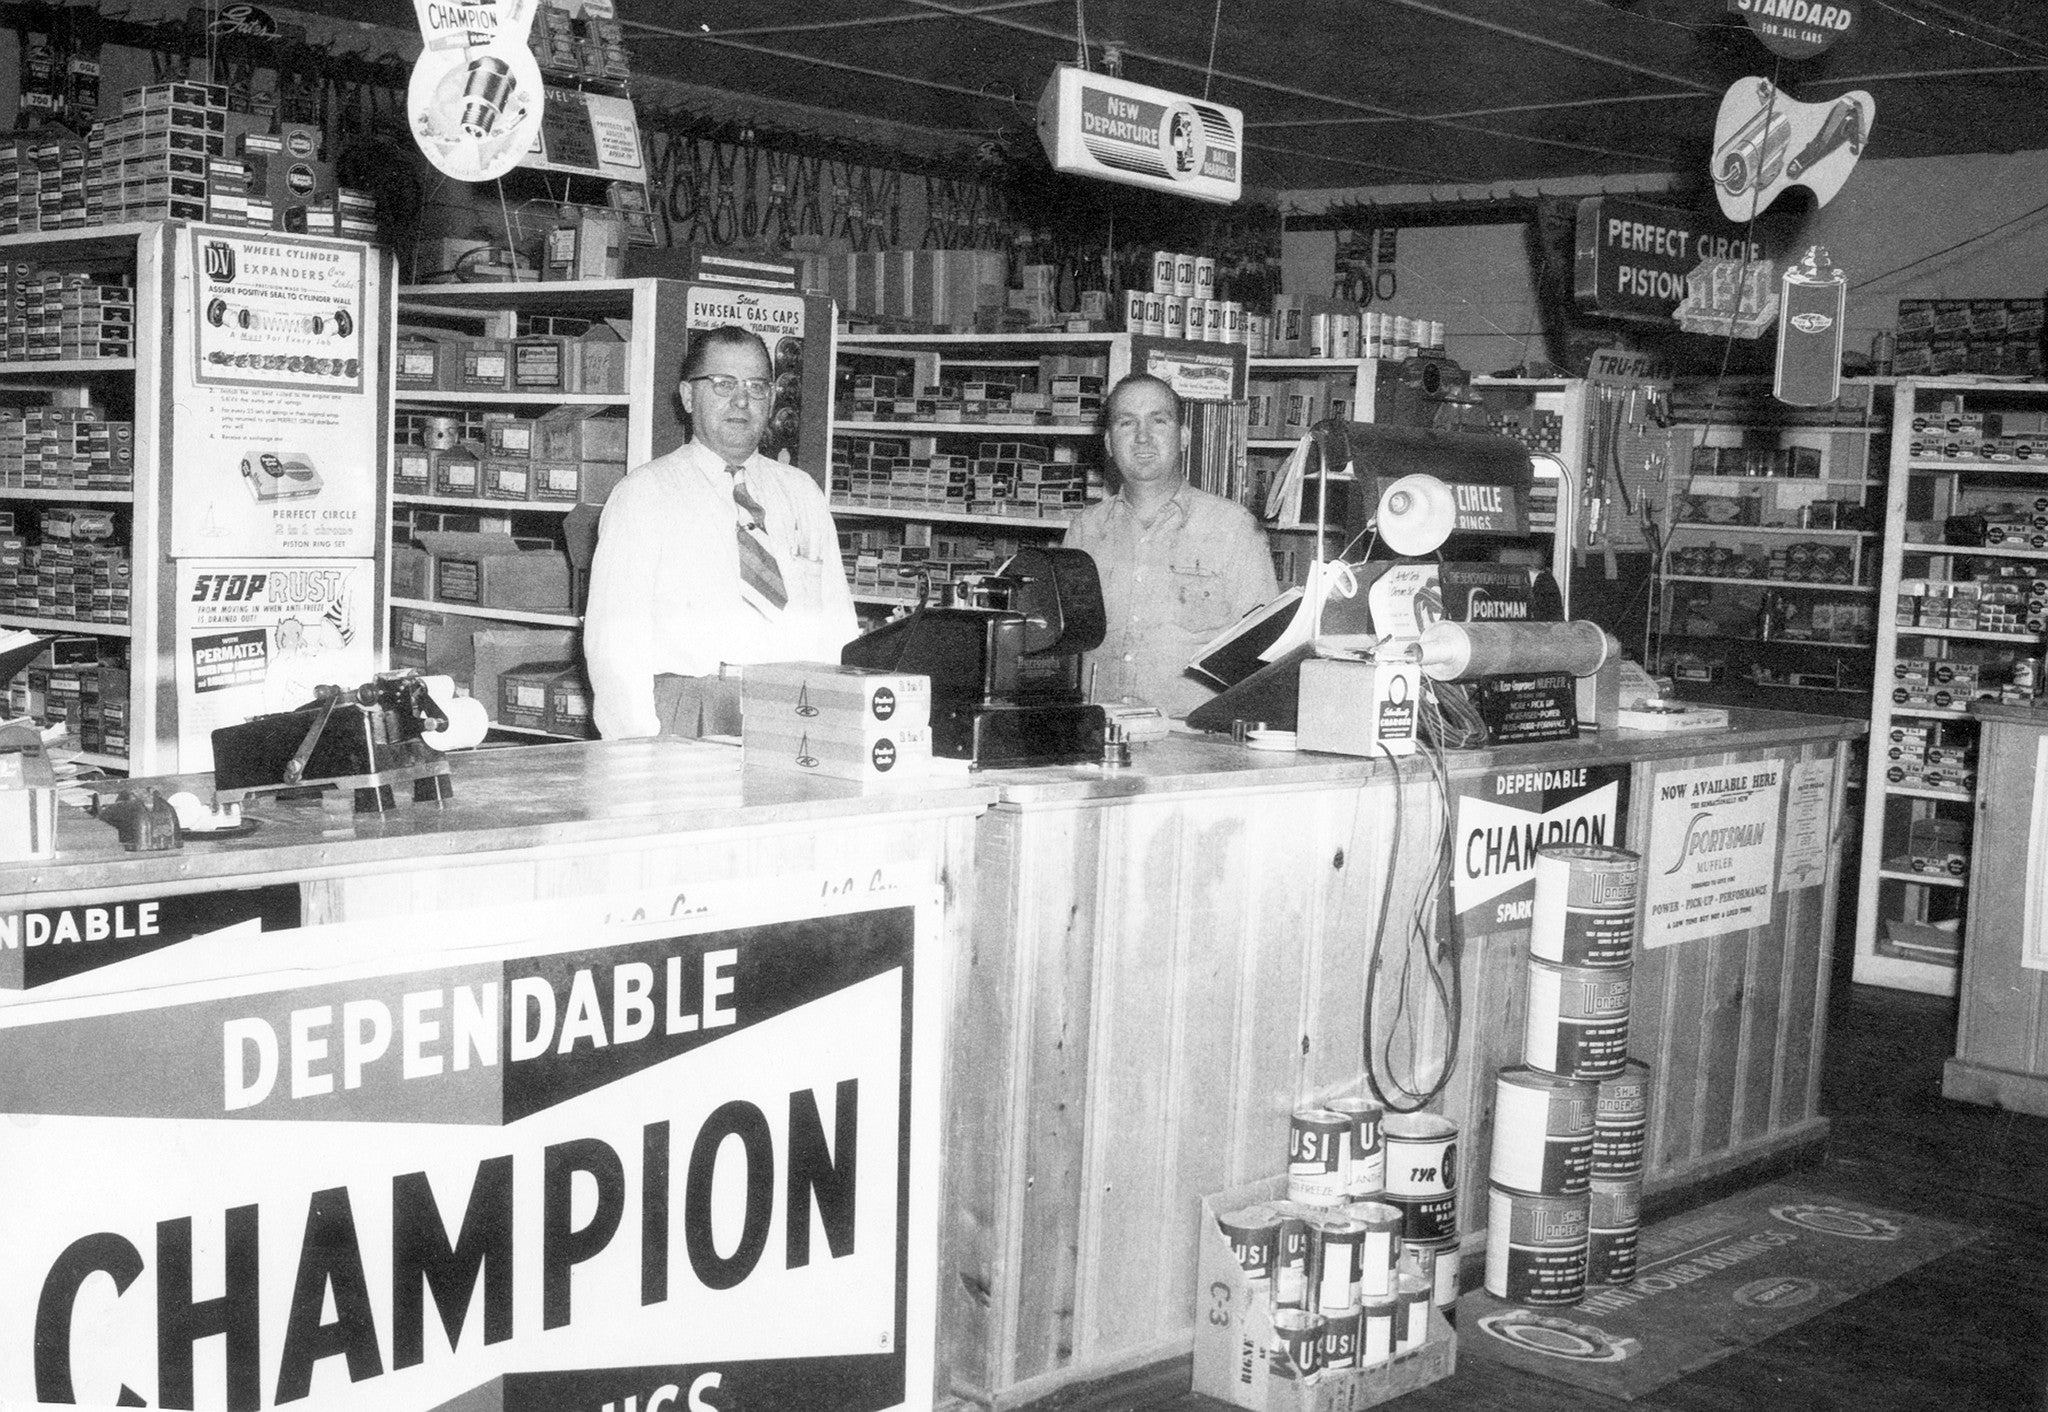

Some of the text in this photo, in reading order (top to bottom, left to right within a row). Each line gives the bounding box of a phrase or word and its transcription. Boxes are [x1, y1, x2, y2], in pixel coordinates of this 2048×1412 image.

[428, 3, 498, 31] CHAMPION
[1737, 0, 1852, 31] STANDARD
[1762, 22, 1823, 44] FOR ALL CARS
[544, 89, 569, 103] VEL
[1107, 96, 1140, 120] NEW
[1083, 111, 1160, 147] DEPARTURE
[1212, 149, 1229, 166] BALL
[1204, 163, 1236, 181] BEARINGS
[1608, 218, 1690, 258] PERFECT
[243, 244, 340, 263] WHEEL CYLINDER
[243, 263, 325, 281] EXPANDERS
[1618, 265, 1684, 300] PISTON
[208, 285, 352, 305] ASSURE POSITIVE SEAL TO CYLINDER WALL
[694, 302, 799, 324] EVRSEAL GAS CAPS
[1457, 485, 1503, 512] CIRCLE
[272, 509, 357, 520] PERFECT CIRCLE
[1460, 516, 1491, 530] RINGS
[282, 540, 346, 548] PISTON RING SET
[191, 571, 341, 603] STOP RUST
[198, 605, 217, 613] FROM
[221, 605, 250, 613] MOVING
[252, 605, 260, 613] IN
[263, 604, 282, 613] WHEN
[198, 614, 257, 623] IS DRAINED OUT!
[195, 641, 265, 665] PERMATEX
[1536, 677, 1566, 689] MUFFLER
[1495, 767, 1587, 796] DEPENDABLE
[1660, 772, 1777, 801] NOW AVAILABLE HERE
[1465, 814, 1606, 880] CHAMPION
[1696, 857, 1733, 874] MUFFLER
[1652, 901, 1680, 916] POWER
[1719, 884, 1768, 904] PERFORMANCE
[1496, 900, 1533, 924] SPARK
[0, 901, 160, 952] NDABLE
[223, 949, 739, 1112] DEPENDABLE
[1290, 1127, 1330, 1162] USI
[1410, 1167, 1437, 1182] TYR
[34, 1078, 859, 1412] CHAMPION
[1236, 1244, 1268, 1265] USI
[1325, 1334, 1355, 1354] USI
